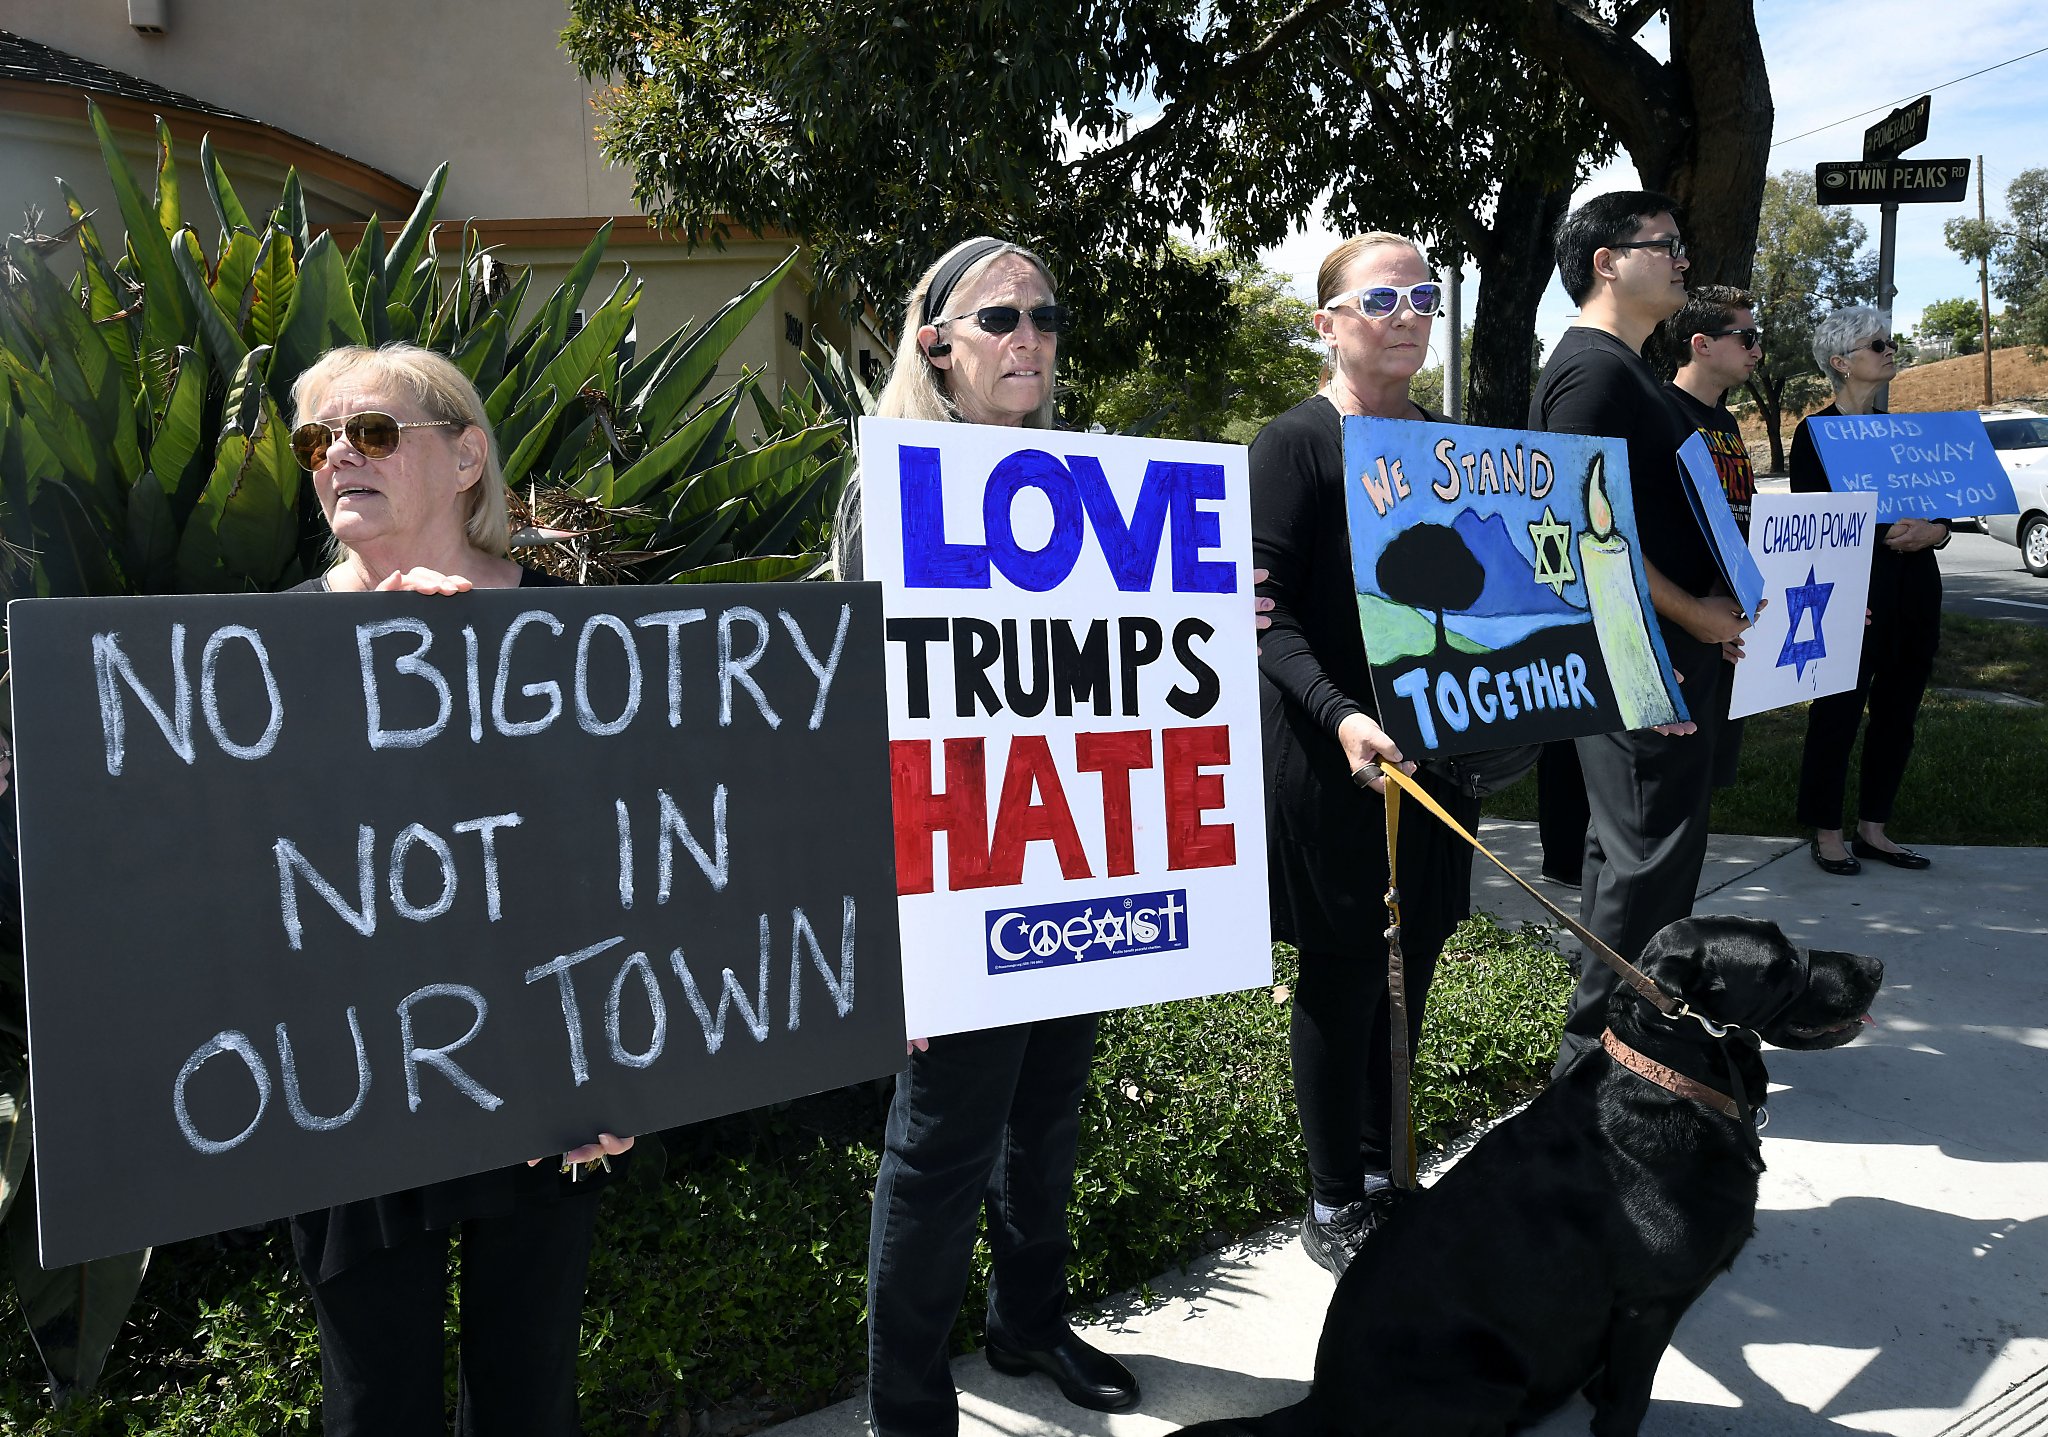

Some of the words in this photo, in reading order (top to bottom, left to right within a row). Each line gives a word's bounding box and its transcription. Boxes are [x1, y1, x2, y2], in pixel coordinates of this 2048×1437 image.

[1873, 109, 1916, 151] POMERADO
[1848, 168, 1887, 190] TWIN
[1893, 166, 1947, 190] PEAKS
[1951, 166, 1966, 178] RD
[1823, 418, 1923, 441] CHABAD
[1890, 441, 1976, 464] POWAY
[1361, 456, 1411, 516] WE
[1433, 438, 1553, 500] STAND
[1842, 473, 1878, 491] WE
[1887, 469, 1956, 489] STAND
[1876, 496, 1938, 515] WITH
[1945, 482, 1998, 508] YOU
[899, 444, 1237, 594] LOVE
[1763, 515, 1817, 554] CHABAD
[1820, 511, 1868, 550] POWAY
[92, 623, 284, 776] NO
[356, 603, 852, 752] BIGOTRY
[886, 617, 1220, 719] TRUMPS
[1393, 652, 1598, 750] TOGETHER
[889, 725, 1237, 896] HATE
[272, 811, 524, 951] NOT
[616, 783, 730, 910] IN
[174, 983, 504, 1154] OUR
[525, 896, 856, 1087] TOWN
